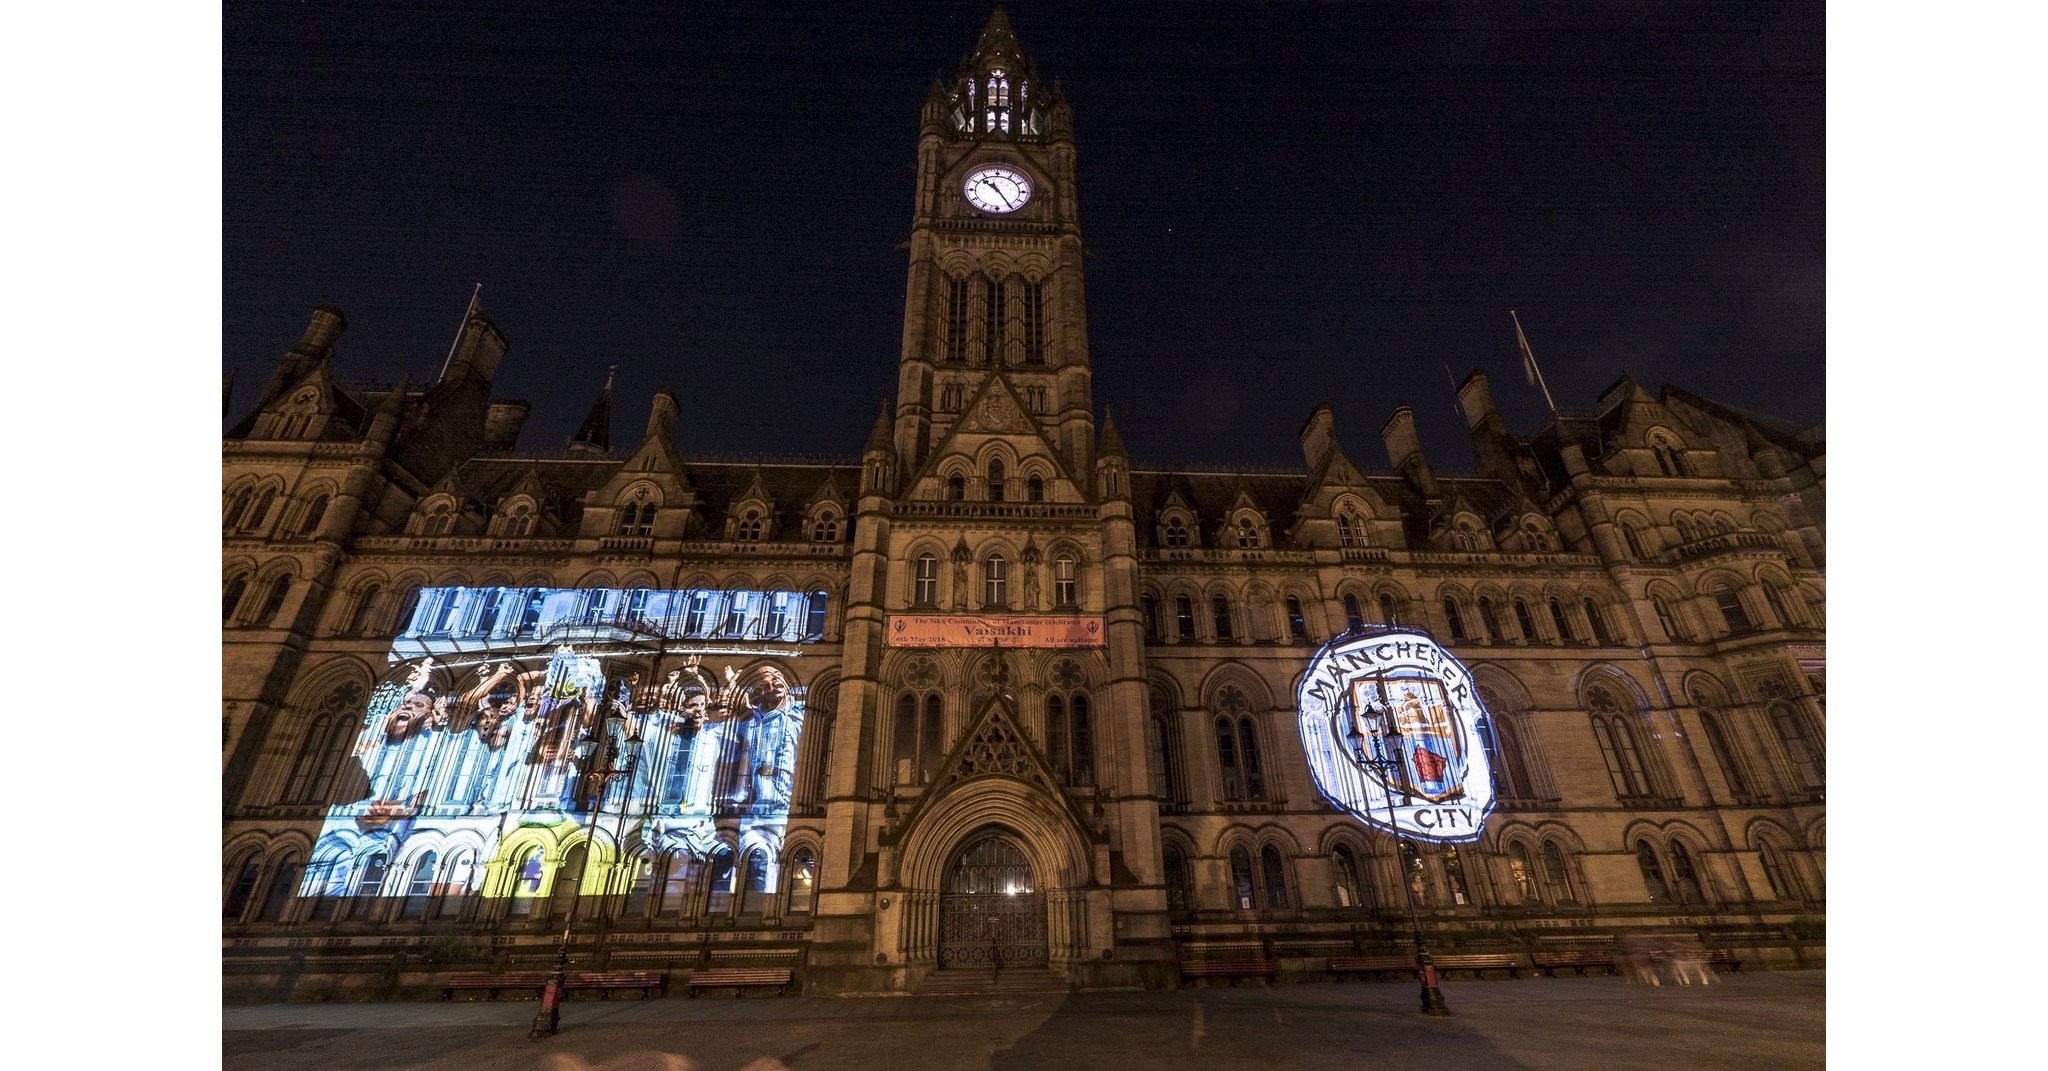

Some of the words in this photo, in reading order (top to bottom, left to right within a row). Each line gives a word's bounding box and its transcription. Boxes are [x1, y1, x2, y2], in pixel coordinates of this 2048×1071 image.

[964, 624, 1032, 636] Vaisakhi
[1308, 641, 1468, 703] MANCHESTER
[1413, 808, 1474, 829] CITY
